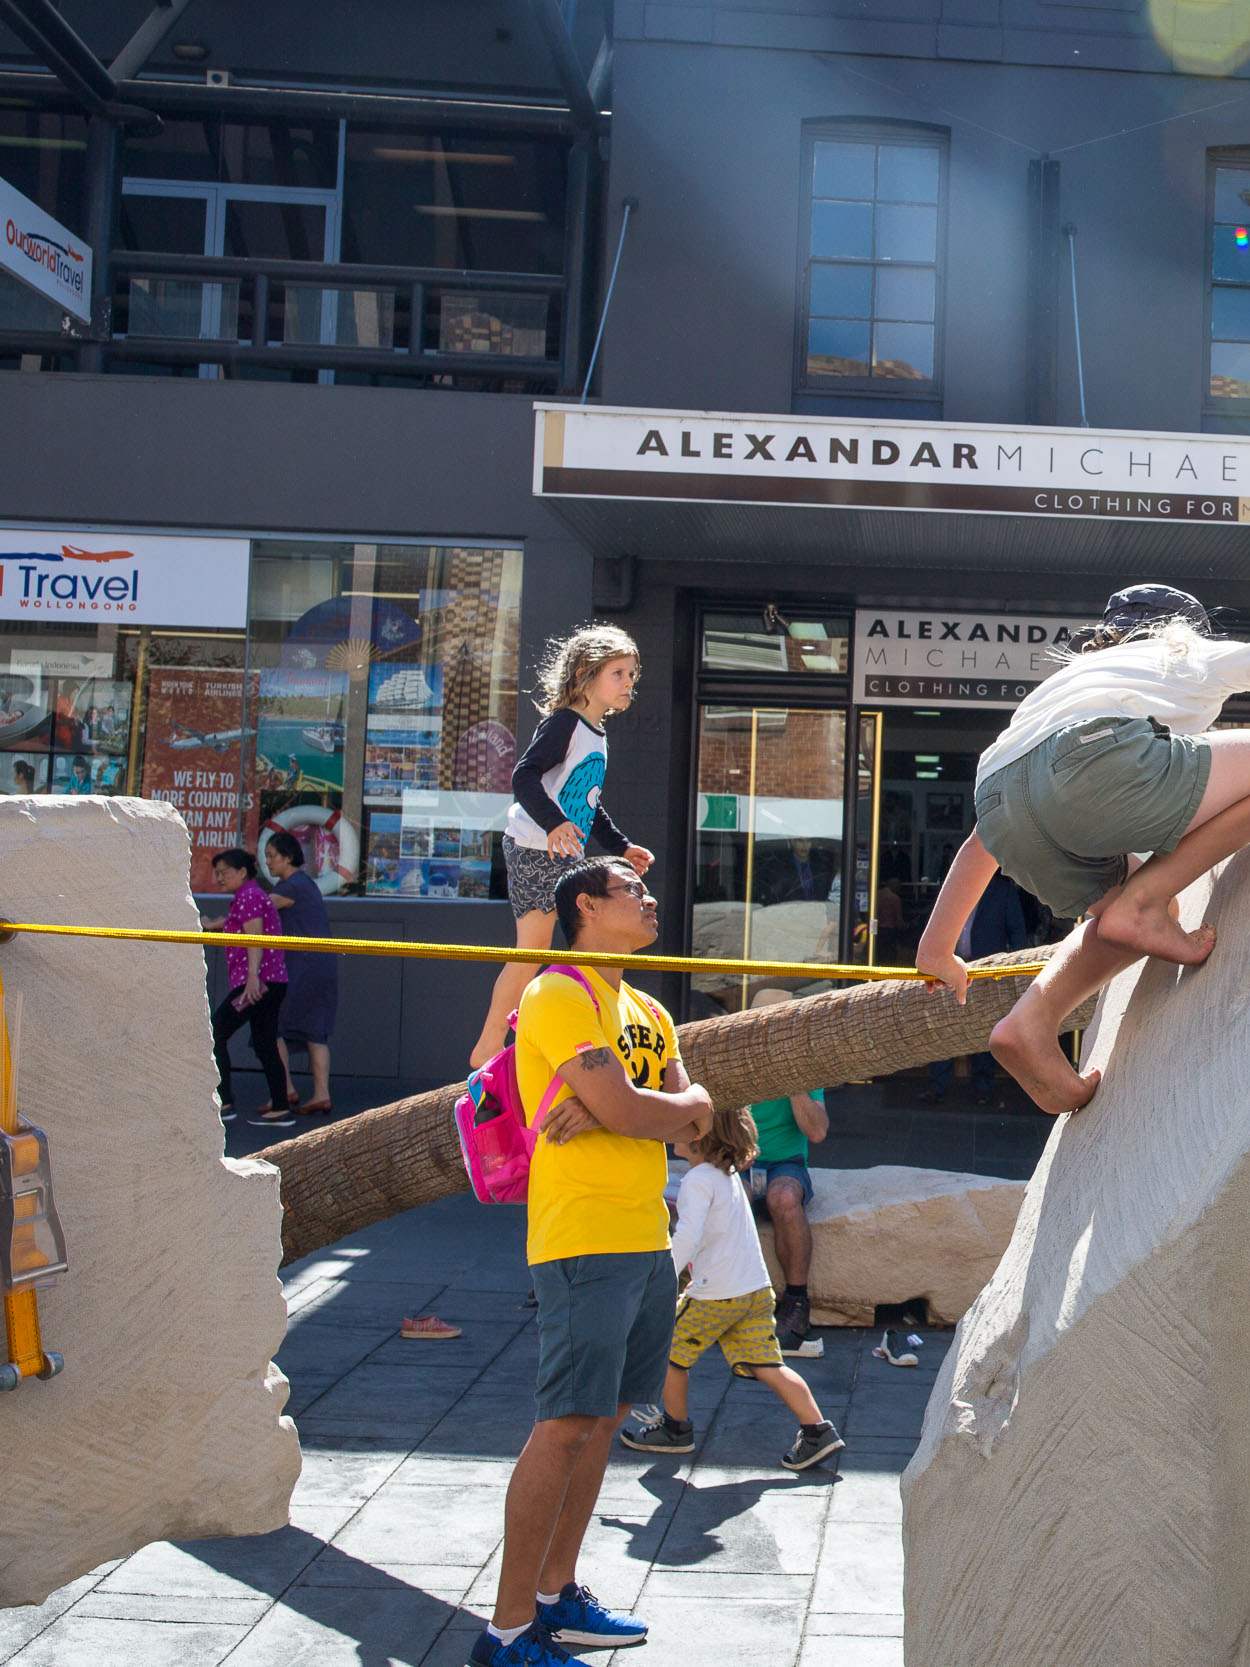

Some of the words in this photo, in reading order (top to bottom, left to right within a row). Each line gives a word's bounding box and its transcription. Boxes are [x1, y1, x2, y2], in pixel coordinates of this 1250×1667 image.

[636, 429, 978, 470] ALEXANDAR
[1034, 493, 1172, 514] CLOTHING
[18, 565, 138, 601] Travel
[20, 600, 137, 611] WOLLONGONG
[867, 619, 1072, 644] ALEXANDA
[866, 648, 1042, 671] MICHAE
[869, 680, 988, 696] CLOTHING
[173, 771, 193, 787] WE
[196, 771, 216, 788] FLY
[220, 773, 234, 788] TO
[151, 789, 185, 806] MORE
[206, 811, 232, 827] ANY
